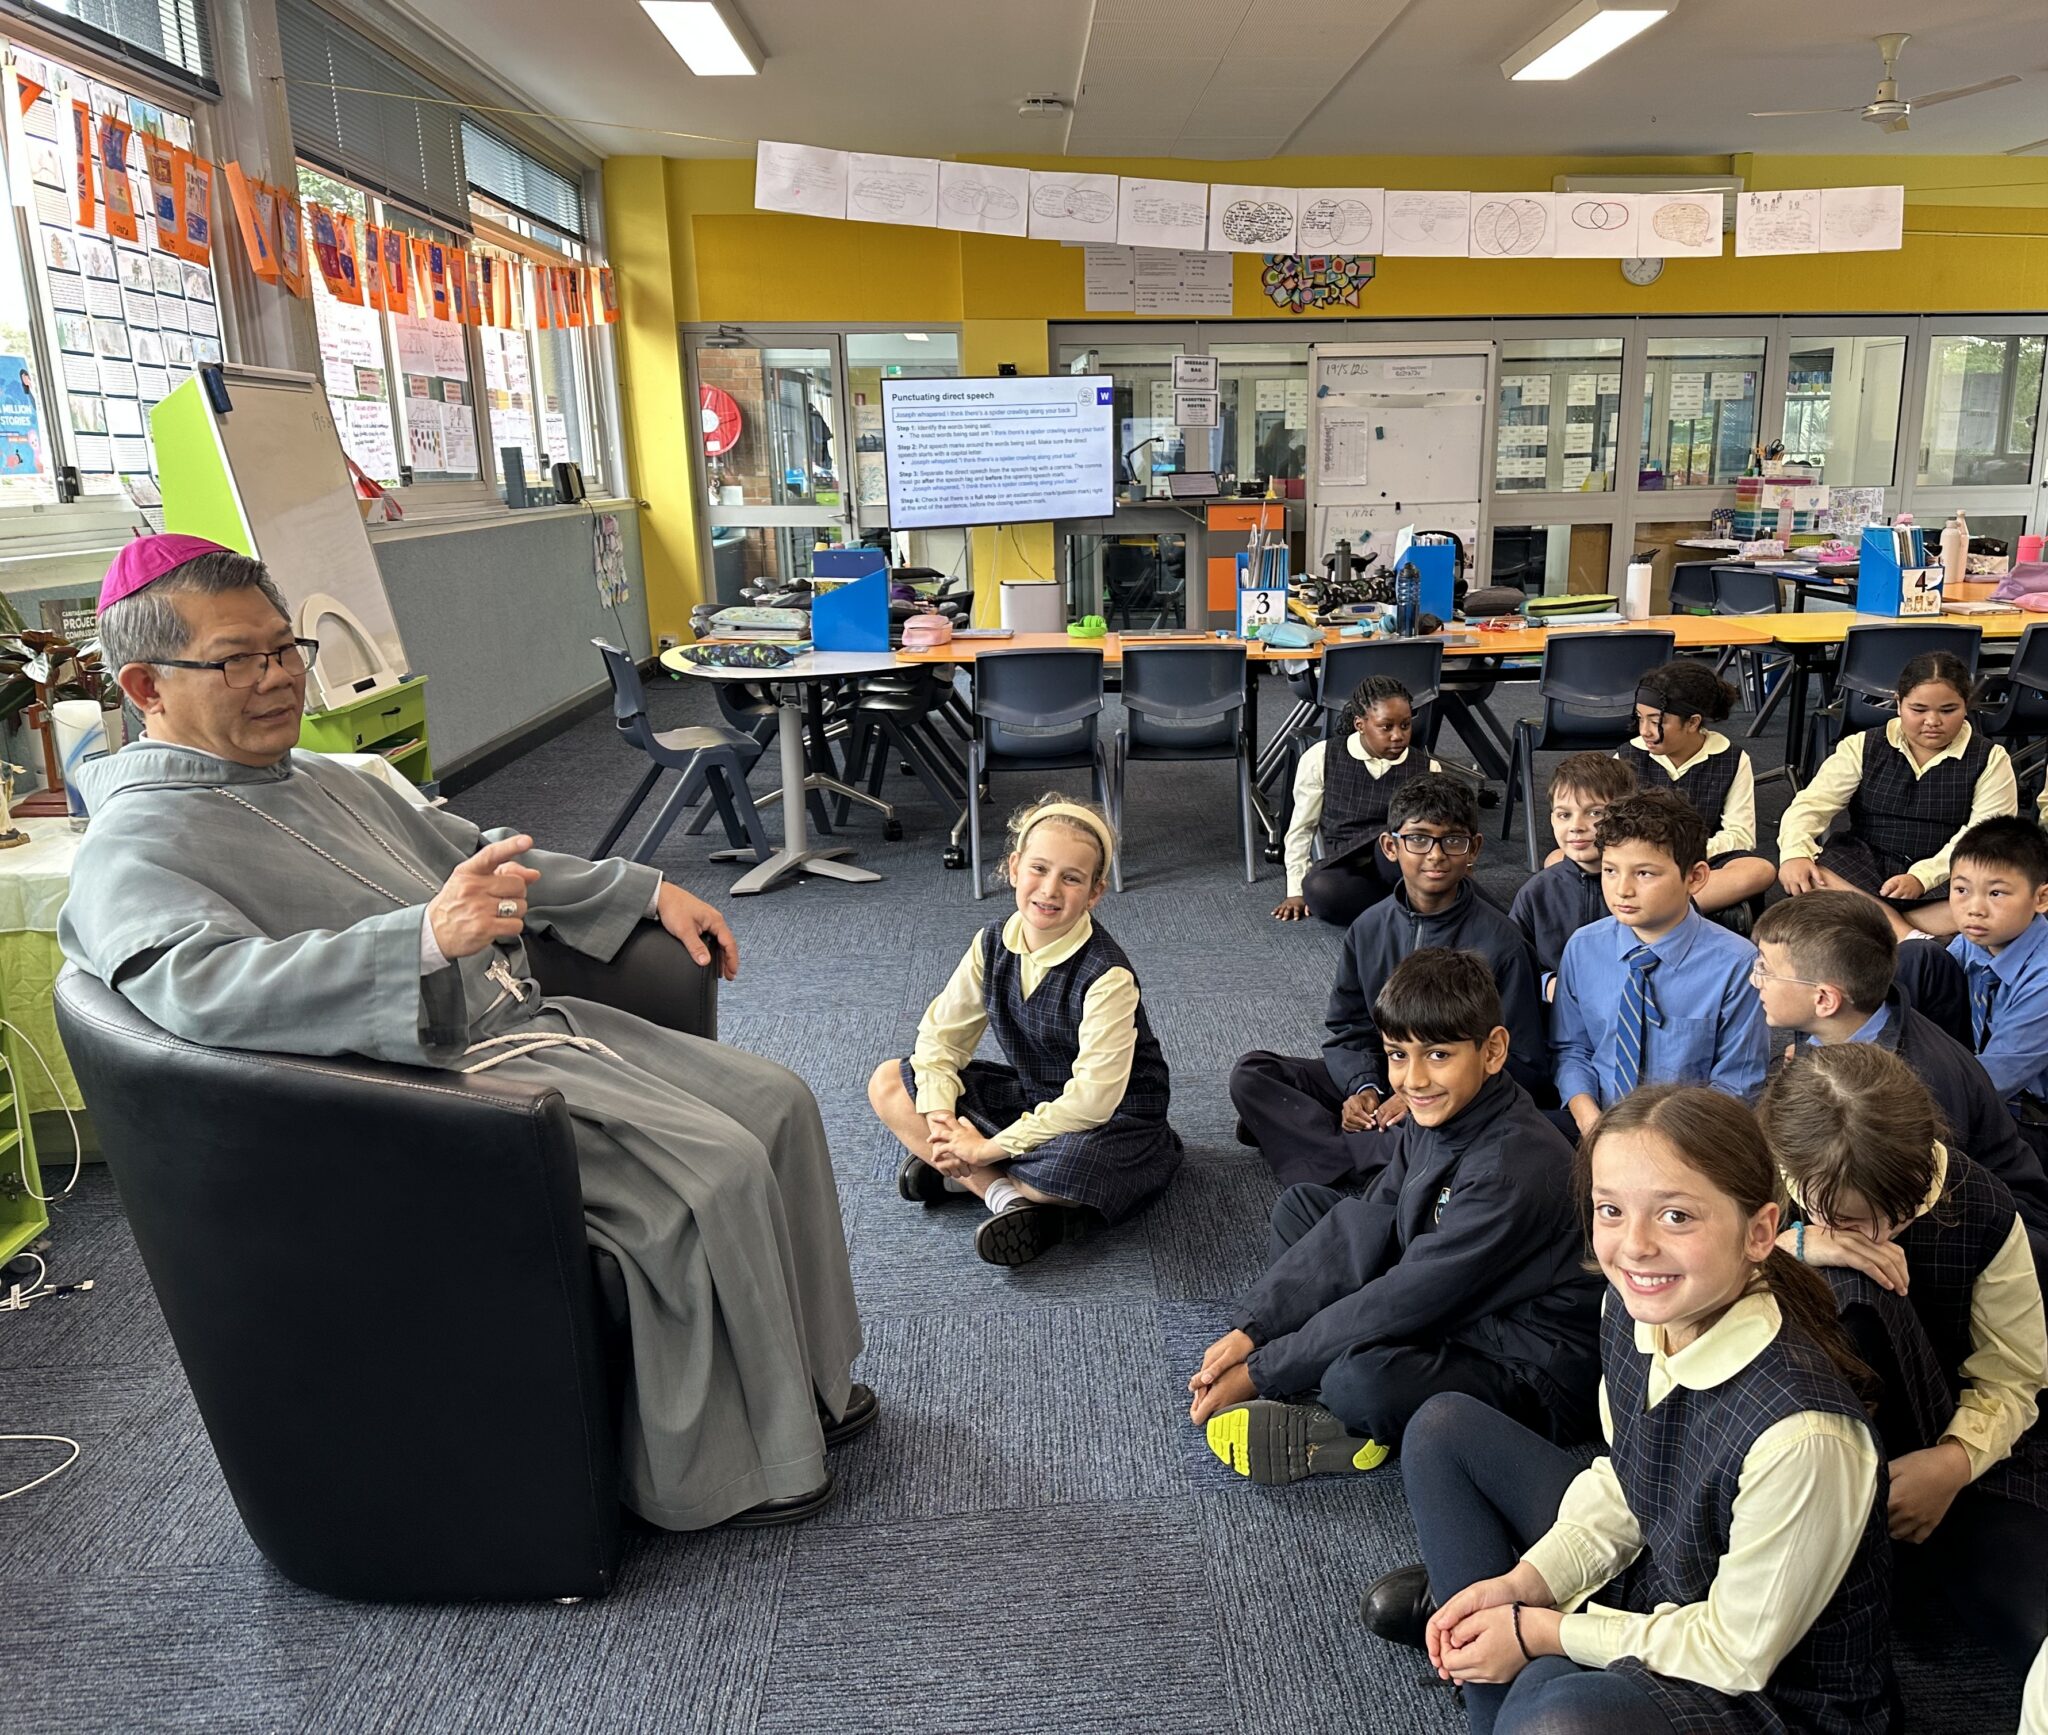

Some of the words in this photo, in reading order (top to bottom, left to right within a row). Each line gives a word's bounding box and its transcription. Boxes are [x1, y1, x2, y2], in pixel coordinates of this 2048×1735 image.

[892, 394, 941, 403] Punctuating
[966, 392, 994, 401] speech
[1100, 392, 1109, 400] W
[1915, 571, 1928, 592] 4
[1256, 592, 1270, 614] 3
